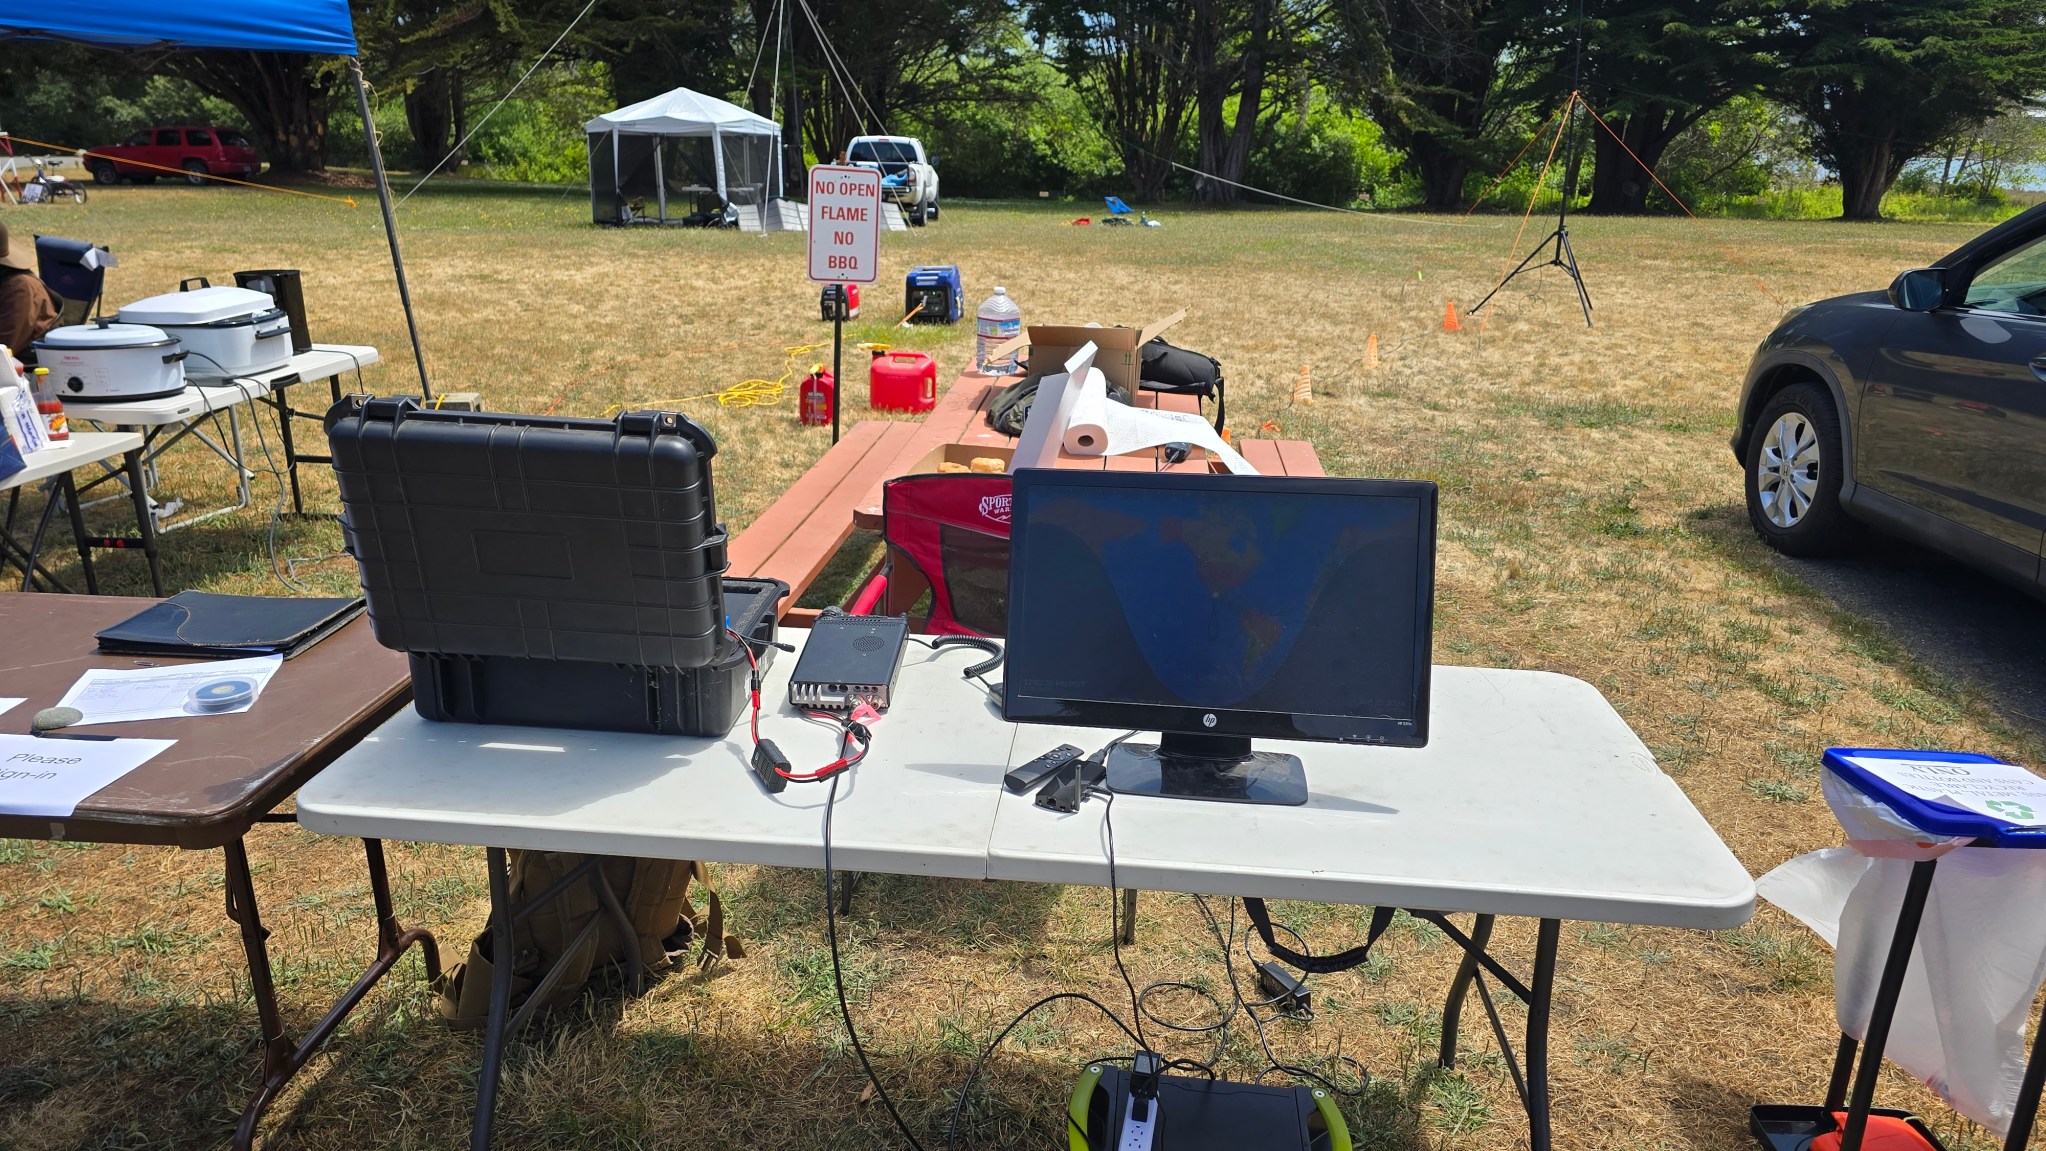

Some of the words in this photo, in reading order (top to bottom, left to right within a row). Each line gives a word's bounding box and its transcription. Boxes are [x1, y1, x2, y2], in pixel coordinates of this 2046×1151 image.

[815, 181, 835, 195] NO
[839, 182, 875, 197] OPEN
[821, 205, 868, 222] FLAME
[833, 231, 854, 245] NO
[828, 255, 858, 270] BBQ
[1203, 713, 1217, 728] hp
[6, 753, 82, 765] Please
[0, 769, 58, 781] ign-in
[1909, 765, 1970, 775] ONLY
